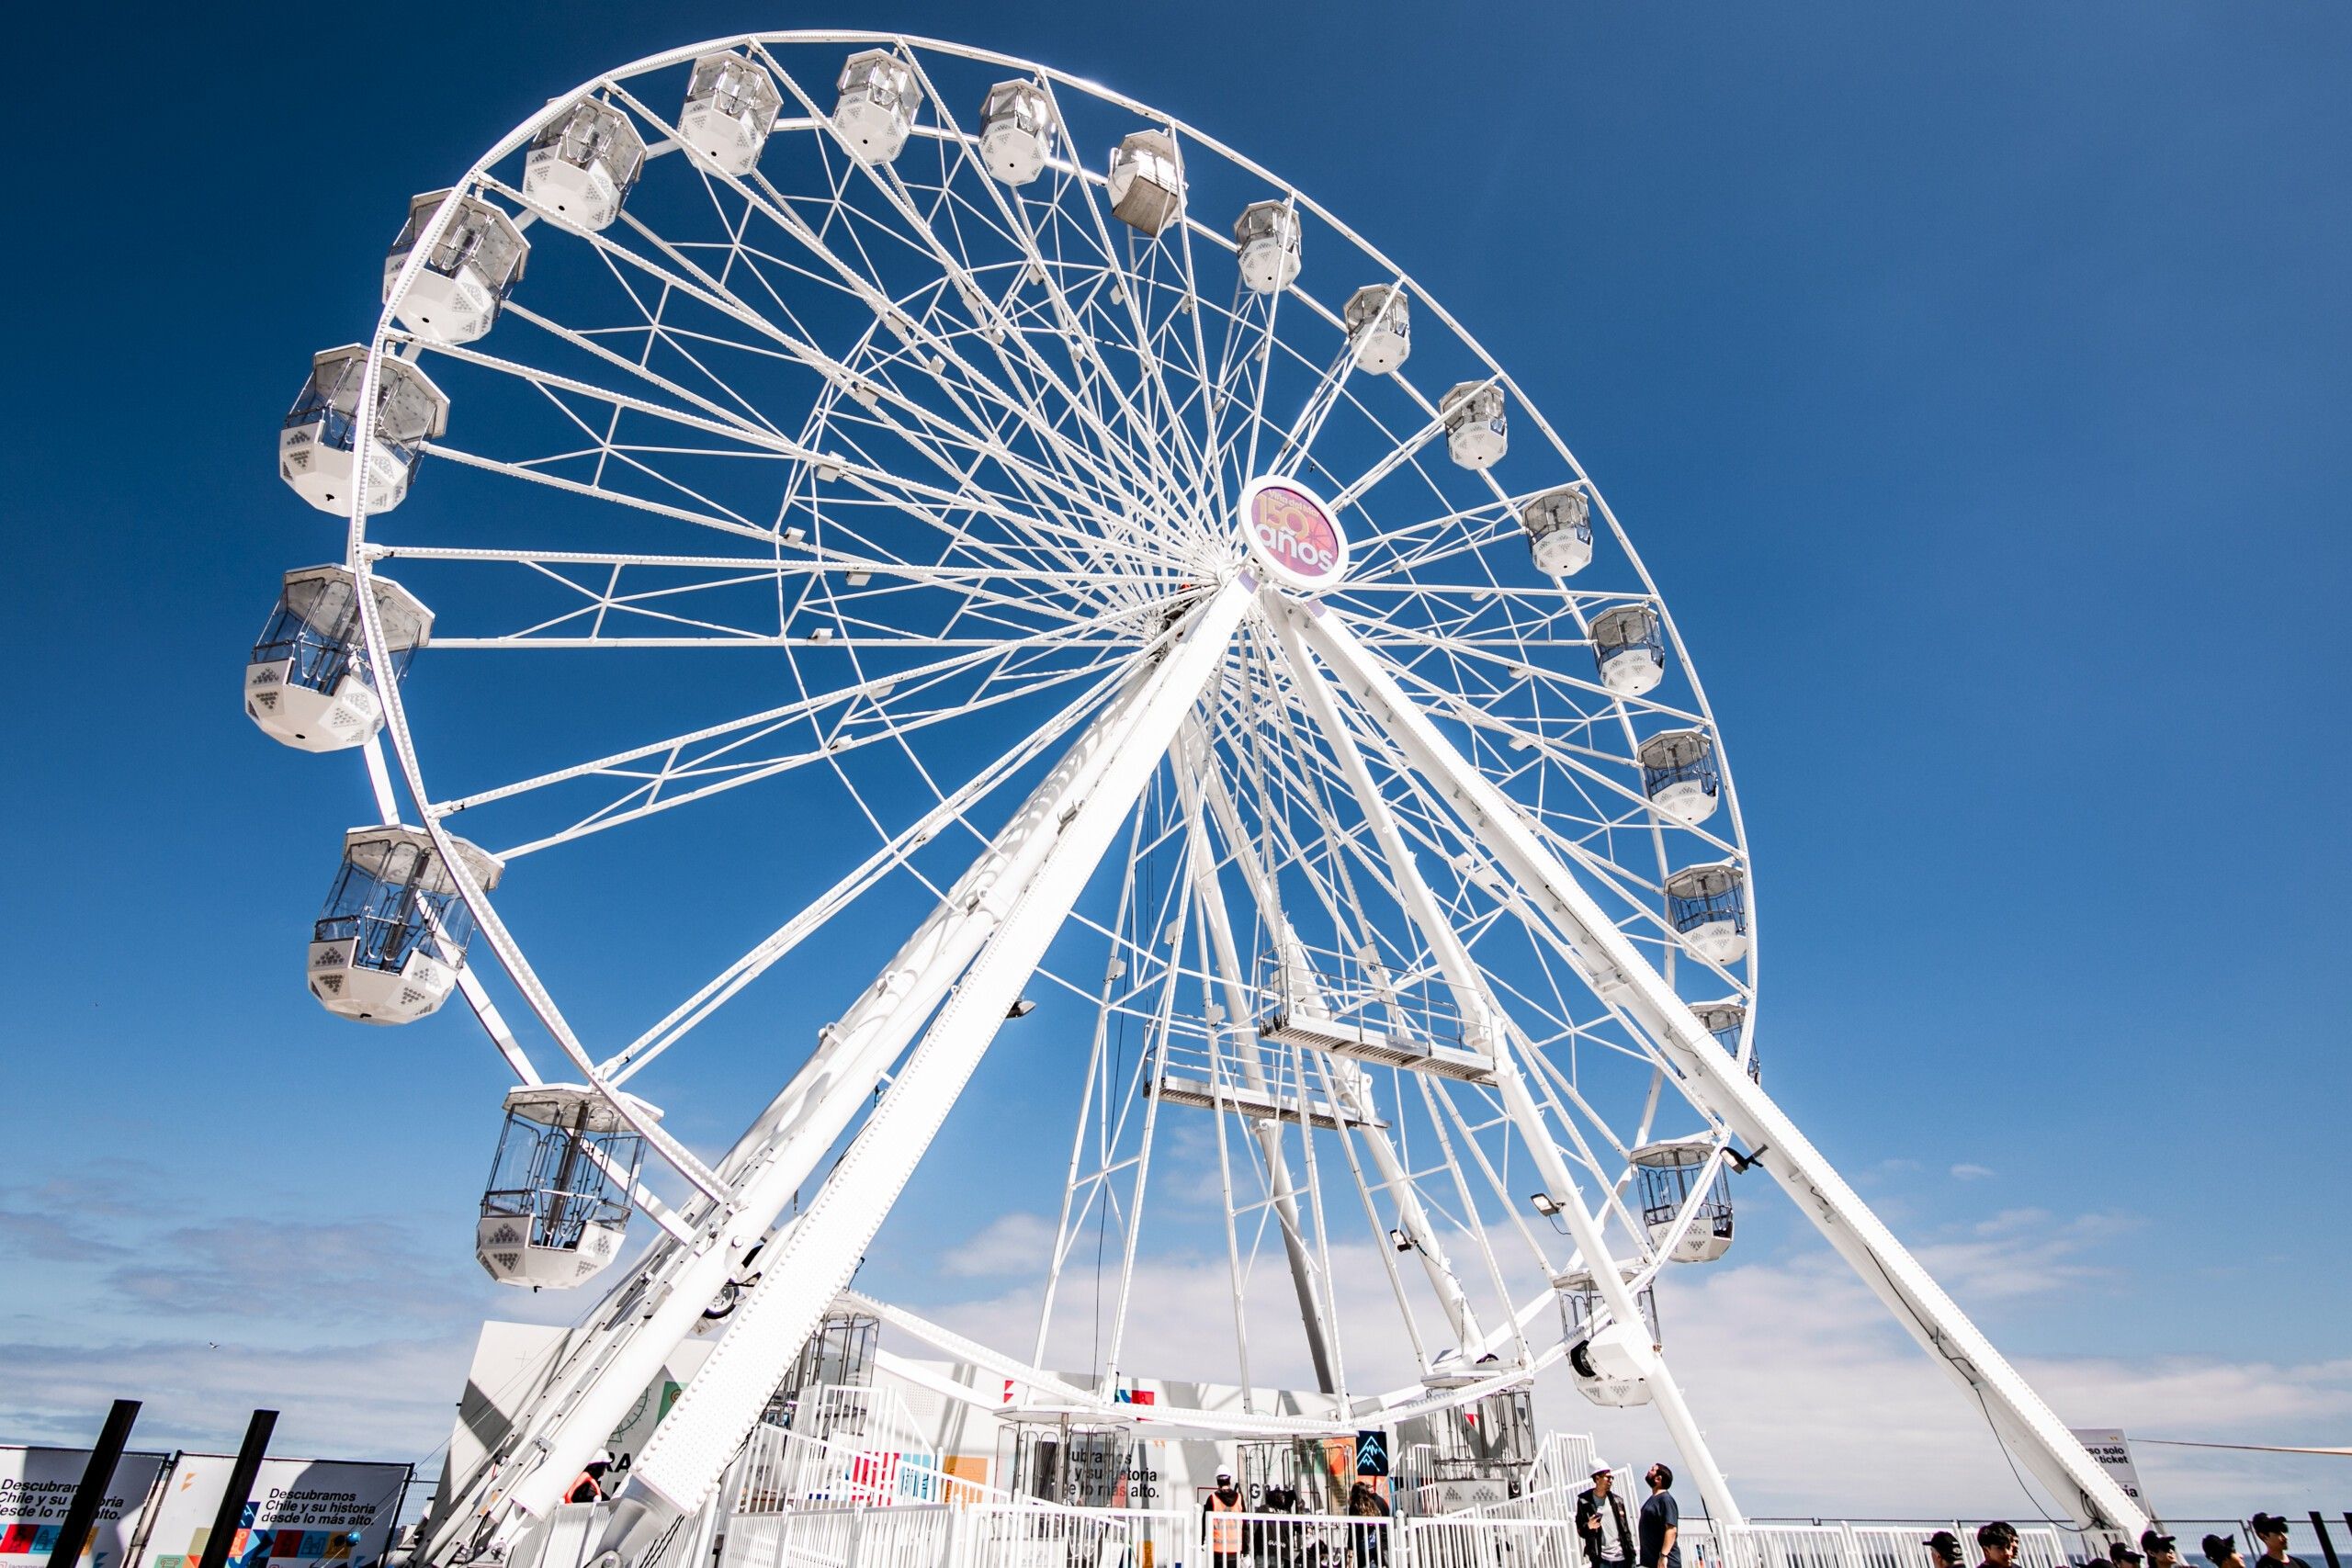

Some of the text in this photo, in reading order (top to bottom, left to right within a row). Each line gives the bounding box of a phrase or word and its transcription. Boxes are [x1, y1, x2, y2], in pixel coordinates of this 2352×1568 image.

[1256, 524, 1332, 571] años
[2103, 1446, 2124, 1455] solo
[2099, 1455, 2129, 1464] ticket
[1075, 1468, 1082, 1482] y
[269, 1488, 356, 1502] Descubramos
[1131, 1484, 1159, 1498] alto.
[0, 1491, 33, 1505] Chile
[37, 1495, 46, 1506] y
[49, 1496, 68, 1506] su
[0, 1505, 36, 1517] esde
[40, 1506, 53, 1517] lo
[266, 1500, 376, 1514] Chile y su historia
[261, 1512, 375, 1526] desde lo más alto.
